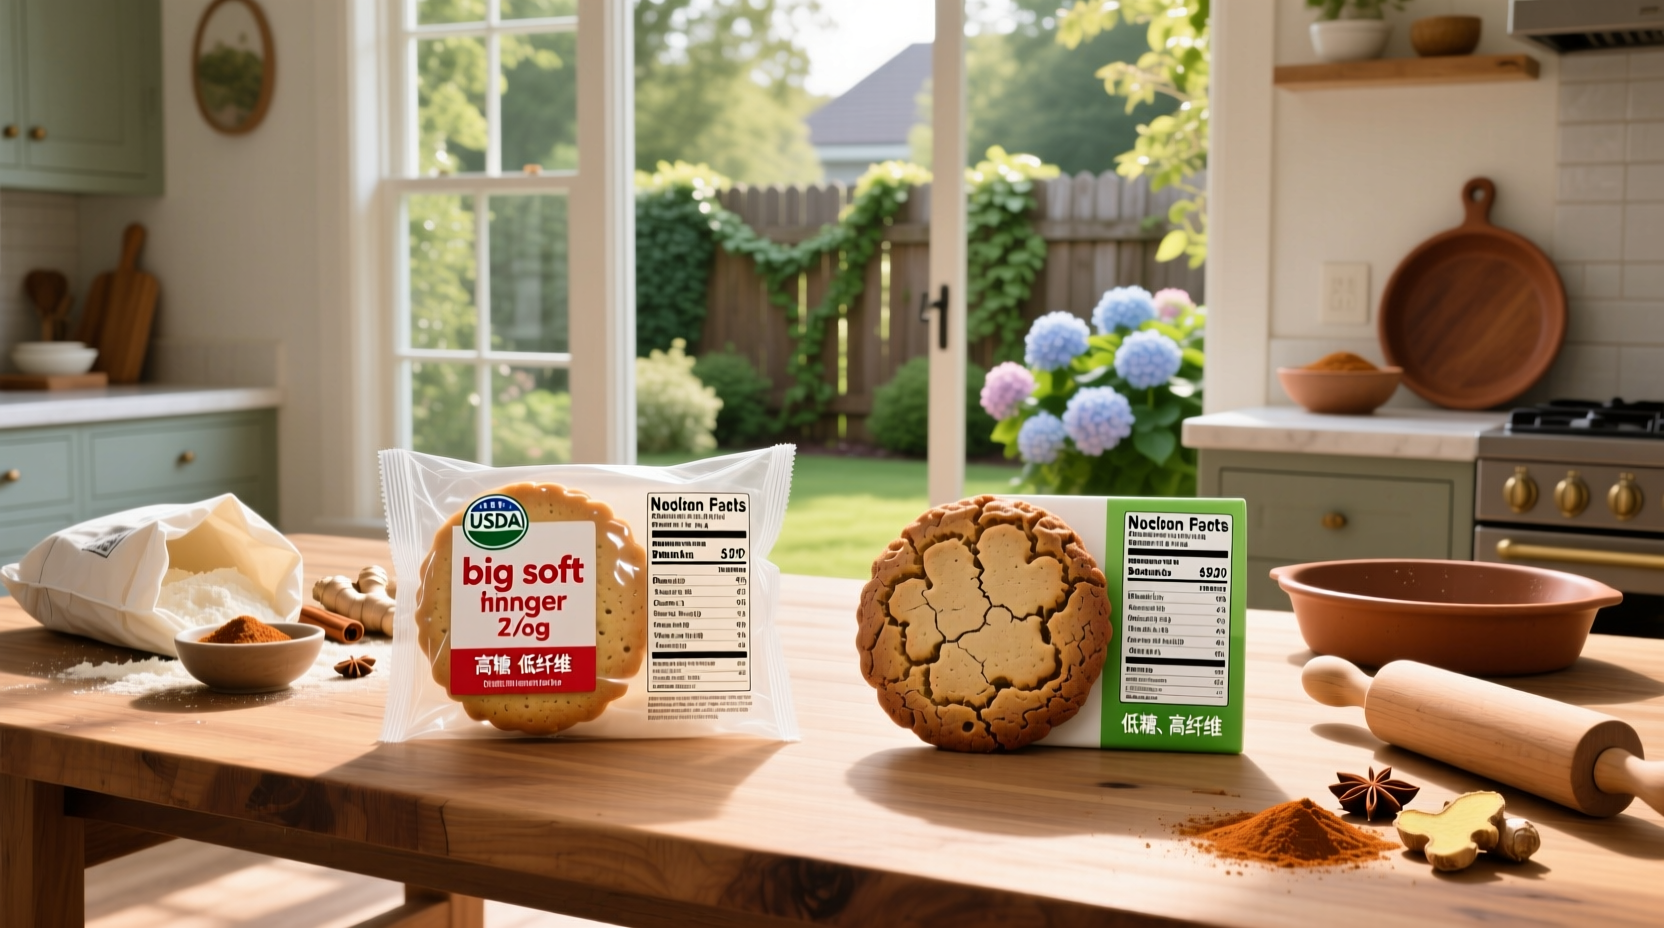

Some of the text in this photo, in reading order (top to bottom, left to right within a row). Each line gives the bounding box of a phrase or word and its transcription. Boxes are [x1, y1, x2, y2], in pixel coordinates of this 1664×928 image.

[470, 512, 523, 529] USDA
[462, 554, 585, 592] big soft
